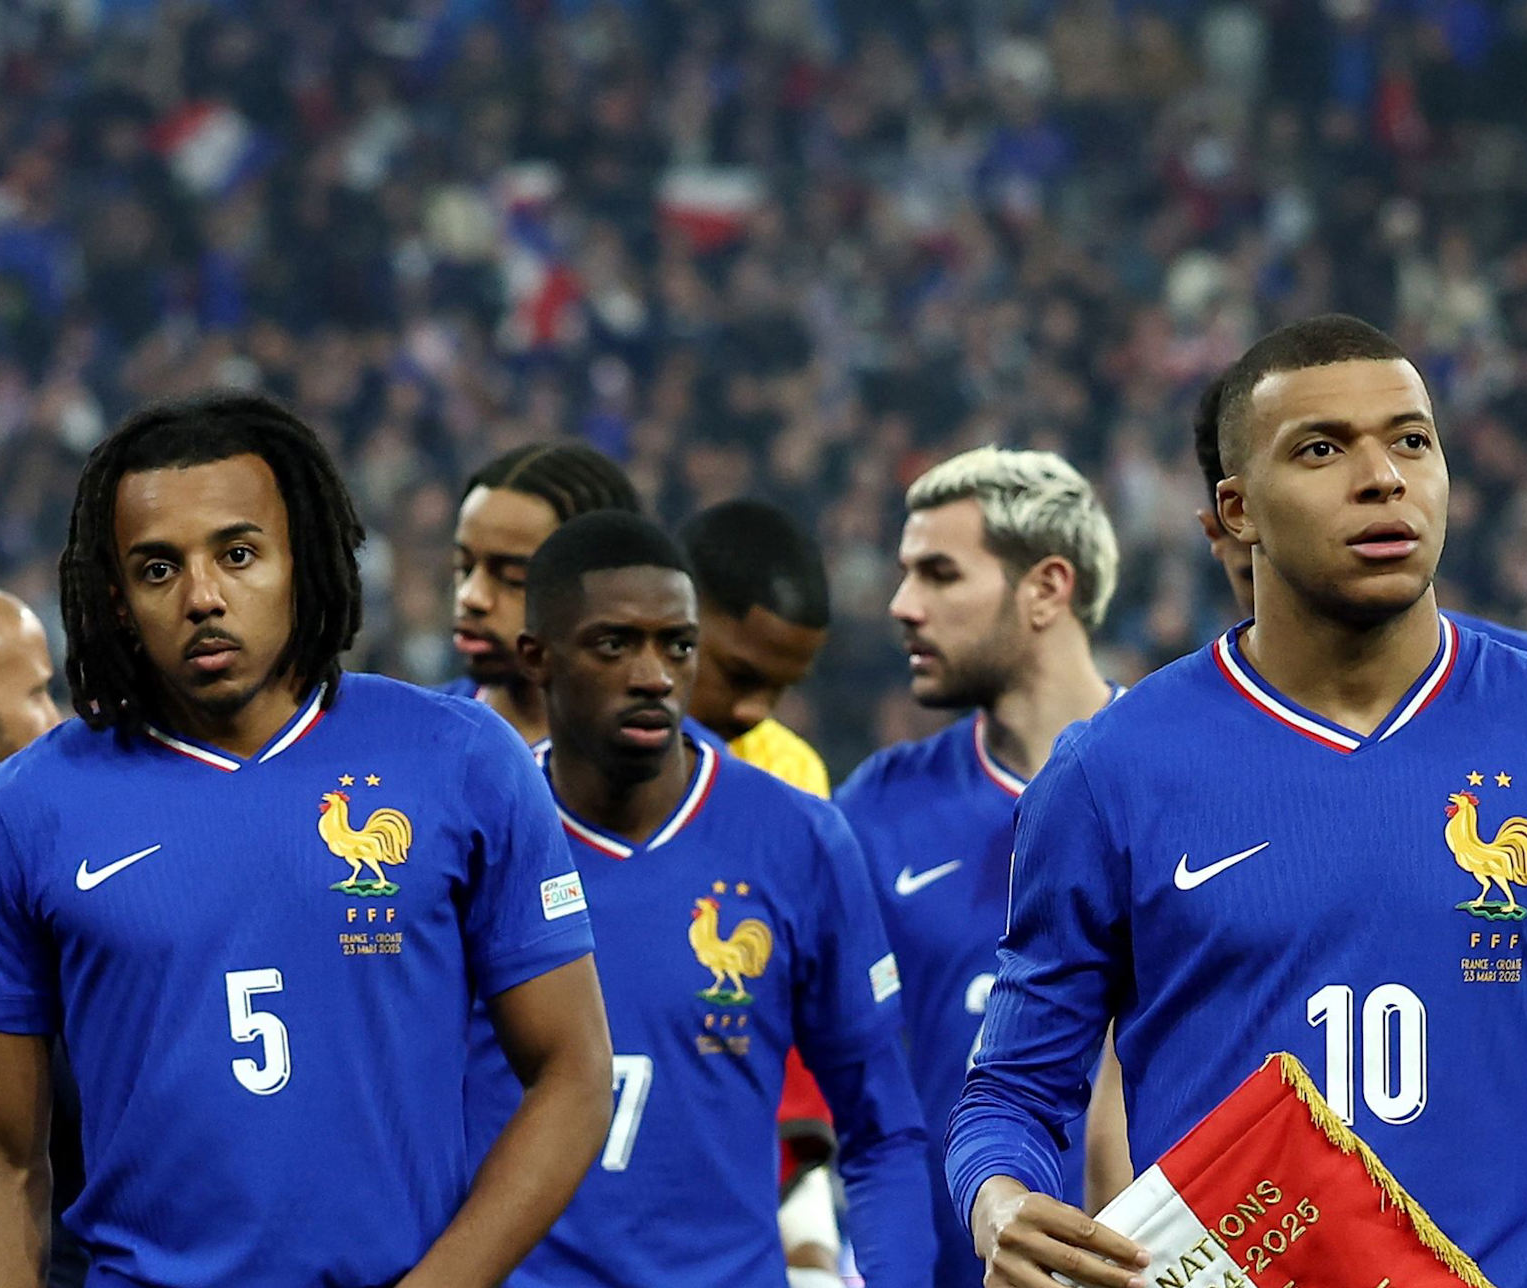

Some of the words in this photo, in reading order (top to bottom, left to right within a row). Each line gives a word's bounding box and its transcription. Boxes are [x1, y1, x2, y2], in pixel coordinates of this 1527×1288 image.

[339, 933, 368, 944] FRANCE
[343, 944, 355, 955] 23
[1461, 958, 1489, 970] FRANCE
[1463, 970, 1475, 982] 23
[1476, 971, 1496, 982] MARS
[1498, 970, 1521, 982] 2025
[224, 966, 292, 1096] 5
[1306, 983, 1428, 1127] 10
[600, 1053, 654, 1173] 7
